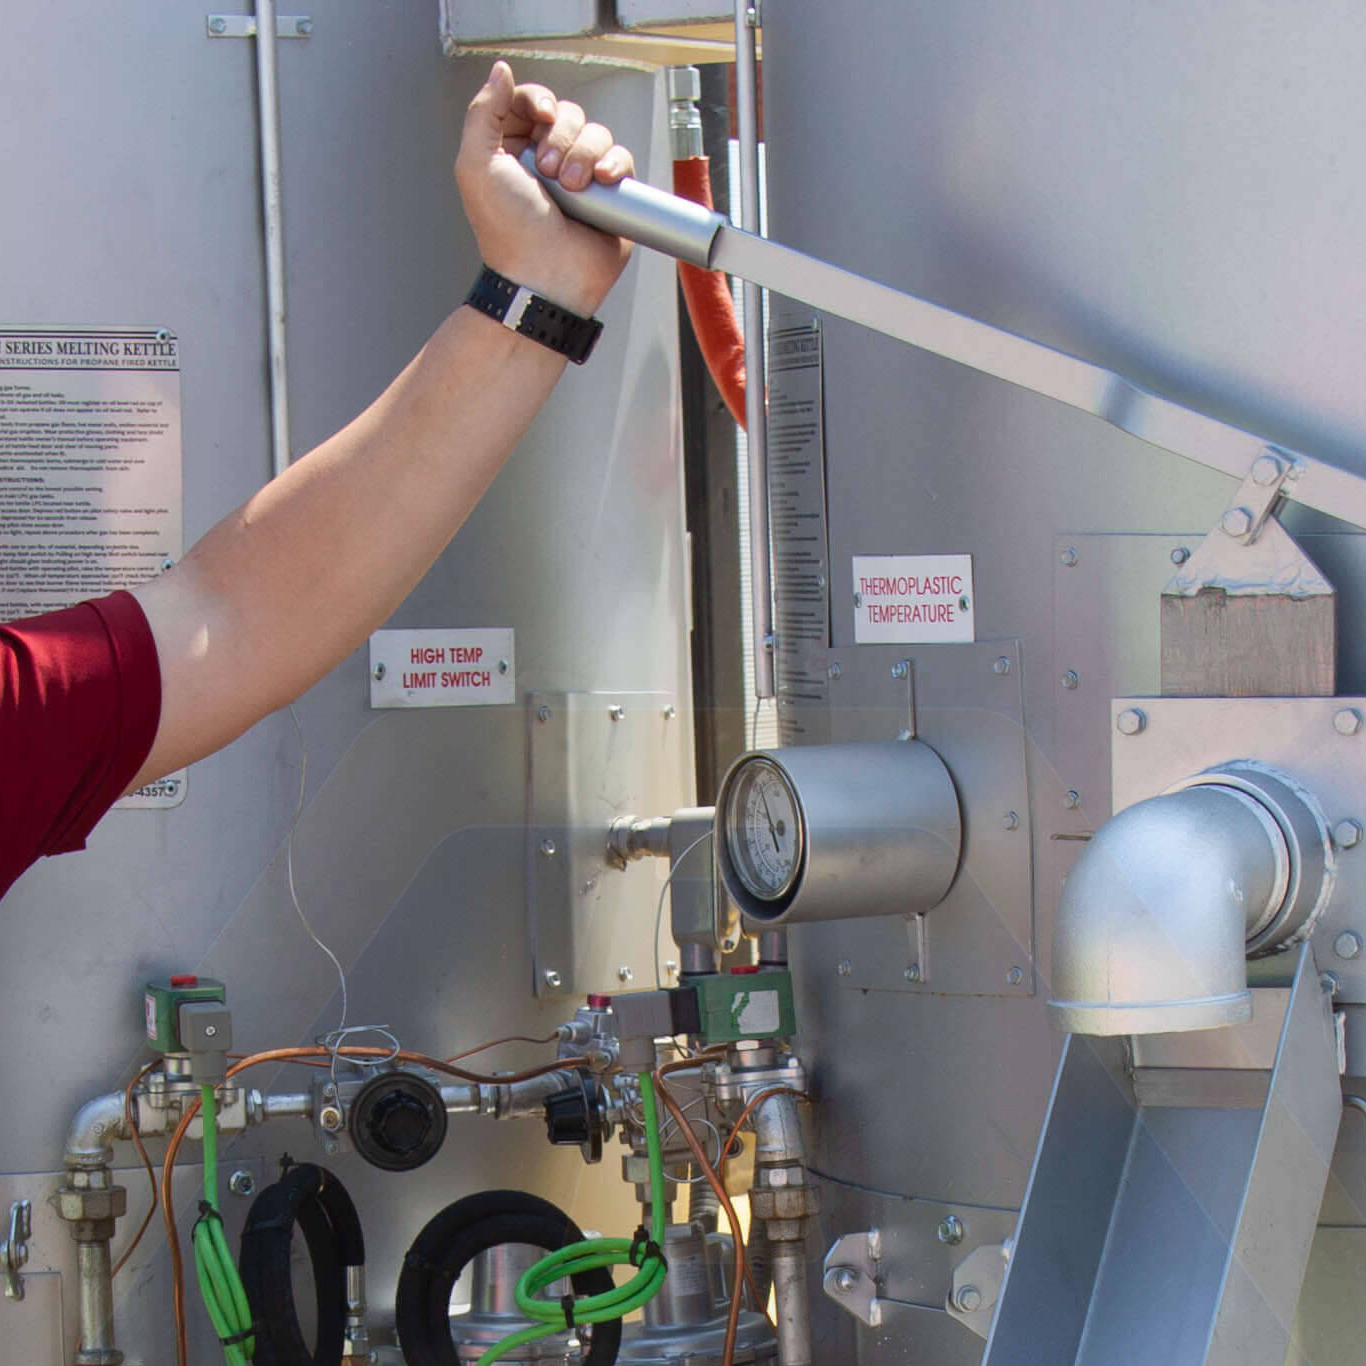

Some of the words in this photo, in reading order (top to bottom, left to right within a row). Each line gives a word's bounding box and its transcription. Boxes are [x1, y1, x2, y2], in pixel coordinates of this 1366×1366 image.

[6, 341, 53, 355] SERIES
[56, 342, 120, 356] MELTING
[123, 343, 177, 357] KETTLE
[61, 358, 78, 367] FOR
[80, 358, 120, 367] PROPANE
[122, 359, 146, 367] FIRED
[148, 359, 177, 368] KETTLE
[859, 575, 964, 596] THERMOPLASTIC
[867, 603, 955, 624] TEMPERATURE
[410, 647, 445, 664] HIGH
[450, 647, 484, 664] TEMP
[402, 672, 437, 689] LIMIT
[441, 671, 491, 688] SWITCH
